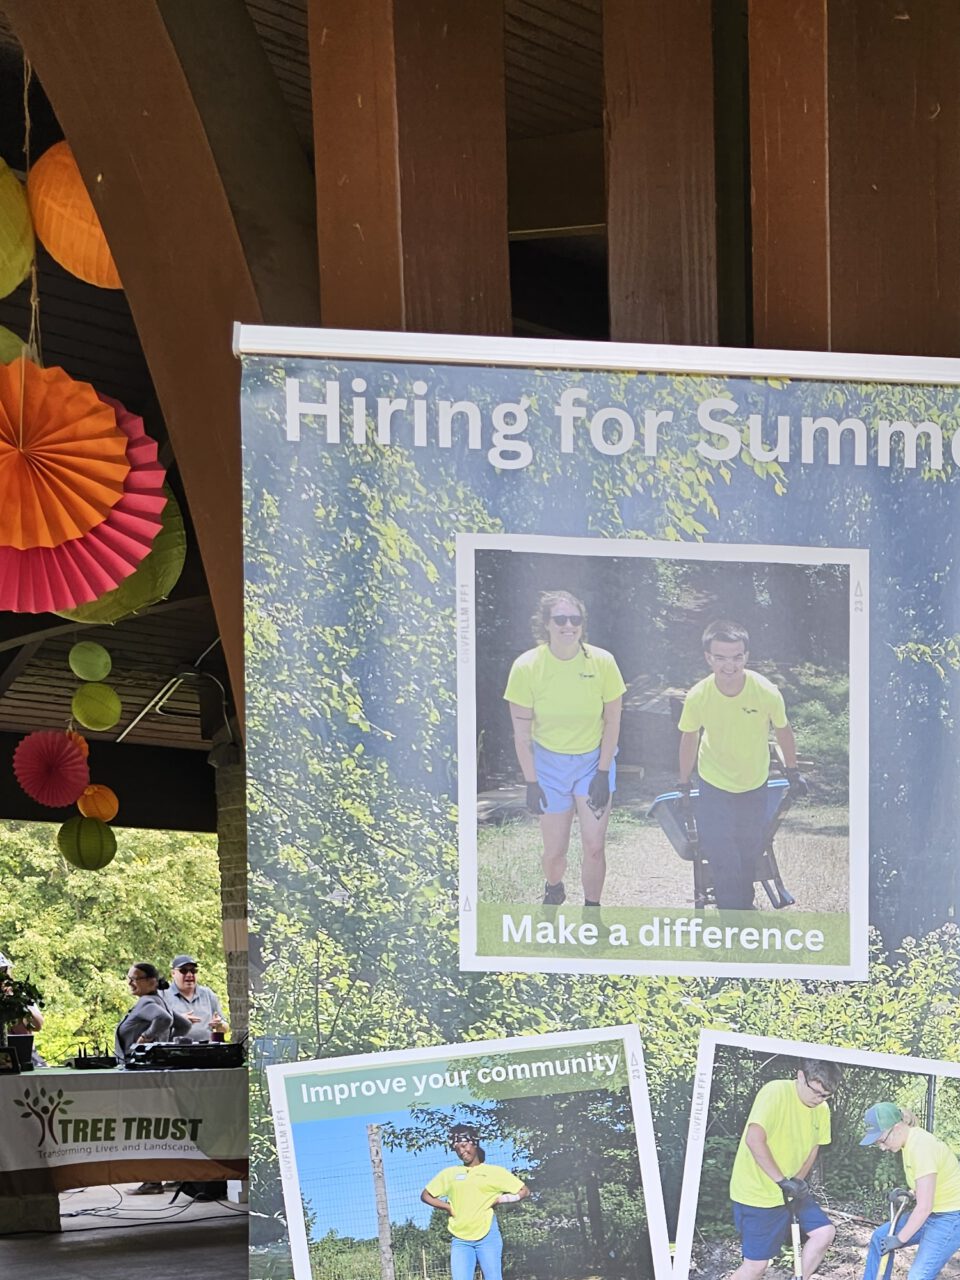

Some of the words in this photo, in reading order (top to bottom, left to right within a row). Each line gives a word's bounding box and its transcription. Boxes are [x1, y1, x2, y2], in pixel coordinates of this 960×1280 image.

[284, 377, 533, 470] Hiring
[555, 388, 674, 458] for
[501, 913, 598, 946] Make
[608, 925, 629, 946] a
[639, 914, 825, 953] difference
[300, 1070, 407, 1106] Improve
[413, 1068, 471, 1098] your
[476, 1049, 620, 1087] community
[58, 1118, 116, 1144] TREE
[122, 1118, 203, 1141] TRUST
